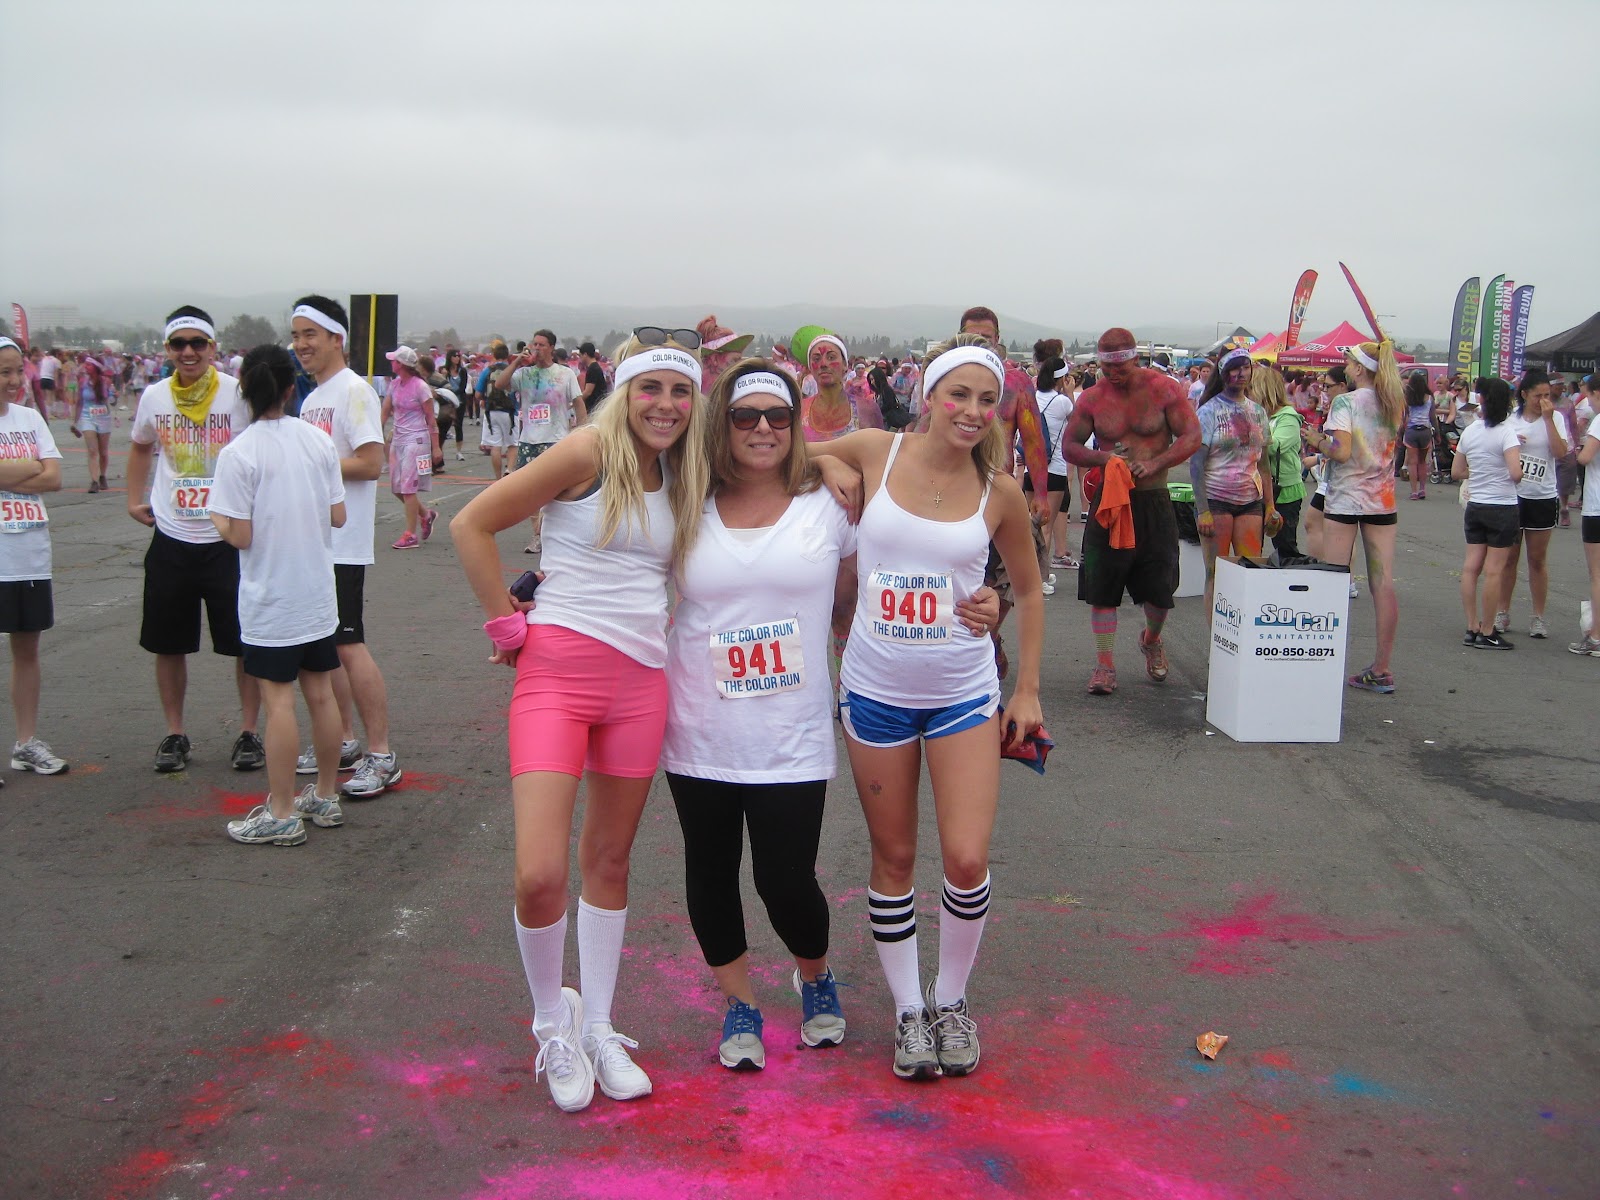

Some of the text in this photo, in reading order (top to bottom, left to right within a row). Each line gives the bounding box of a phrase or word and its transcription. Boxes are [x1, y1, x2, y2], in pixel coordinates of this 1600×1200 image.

[1461, 283, 1479, 337] STORE
[1492, 309, 1503, 349] COLOR
[1501, 314, 1511, 352] COLOR
[1514, 316, 1528, 355] COLOR
[652, 354, 672, 362] COLOR
[1490, 352, 1499, 376] THE
[1500, 355, 1509, 377] THE
[737, 377, 782, 389] COLOR RUNNERS
[155, 413, 231, 429] THE COL RUN
[174, 428, 207, 443] COLOR
[209, 428, 231, 443] RUN
[182, 479, 202, 487] COLOR
[176, 487, 210, 509] 827
[2, 501, 45, 521] 5961
[185, 508, 203, 517] COLOR
[5, 521, 16, 530] THE
[17, 521, 35, 530] COLOR
[875, 573, 947, 589] THE COLOR RUN
[881, 589, 937, 625] 940
[1260, 603, 1336, 632] SoCal
[717, 622, 794, 644] THE COLOR RUN
[873, 620, 947, 639] THE COLOR RUN
[727, 640, 786, 678] 941
[1255, 647, 1335, 657] 800-850-8871
[723, 672, 800, 693] THE COLOR RUN
